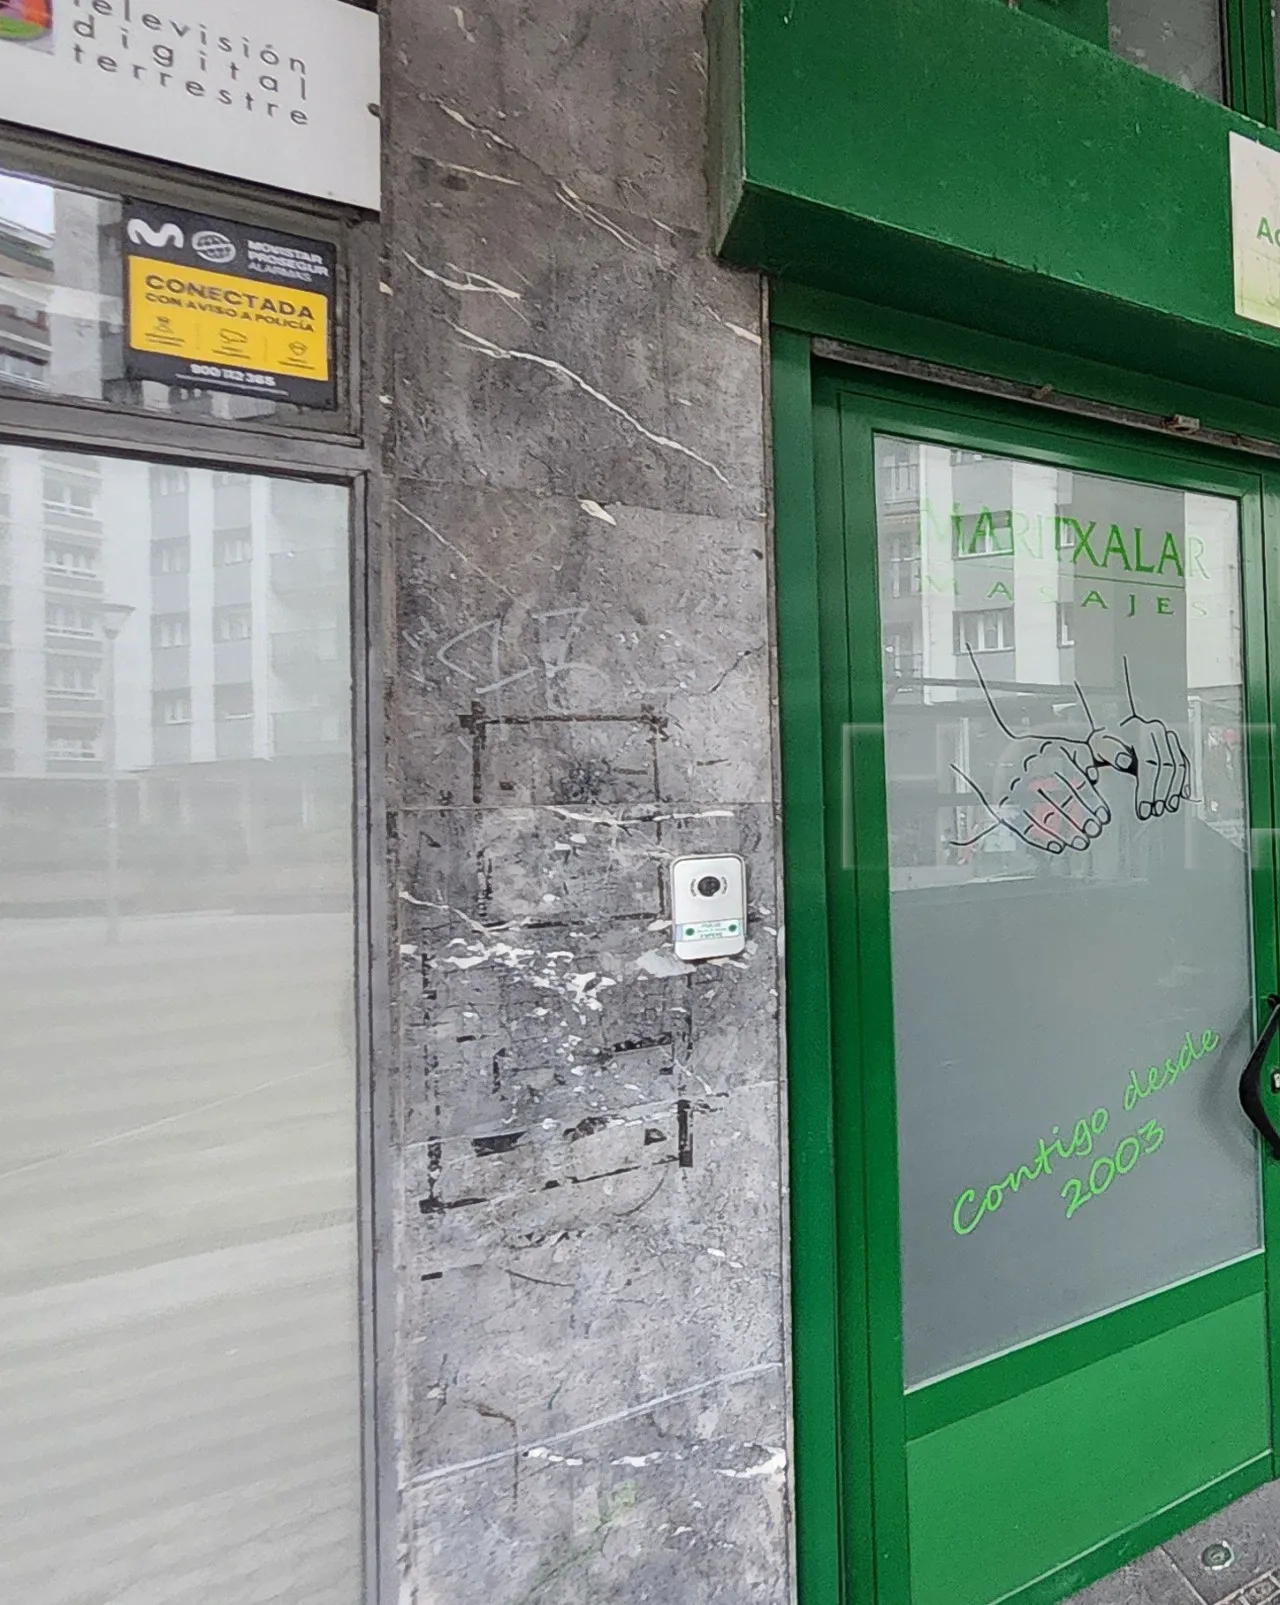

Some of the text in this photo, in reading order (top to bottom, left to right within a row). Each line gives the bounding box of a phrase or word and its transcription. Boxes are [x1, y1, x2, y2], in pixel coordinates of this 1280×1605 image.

[73, 0, 306, 76] elevisión
[73, 15, 306, 101] digital
[72, 43, 308, 125] terrestre
[145, 274, 316, 321] CONECTADA
[145, 293, 182, 308] CON
[186, 301, 237, 318] AVISO
[240, 311, 253, 322] A
[919, 498, 1210, 580] MARITXALAR
[918, 573, 1208, 620] MASAJES
[952, 1027, 1221, 1236] Contigo desde
[1060, 1119, 1166, 1219] 2003
